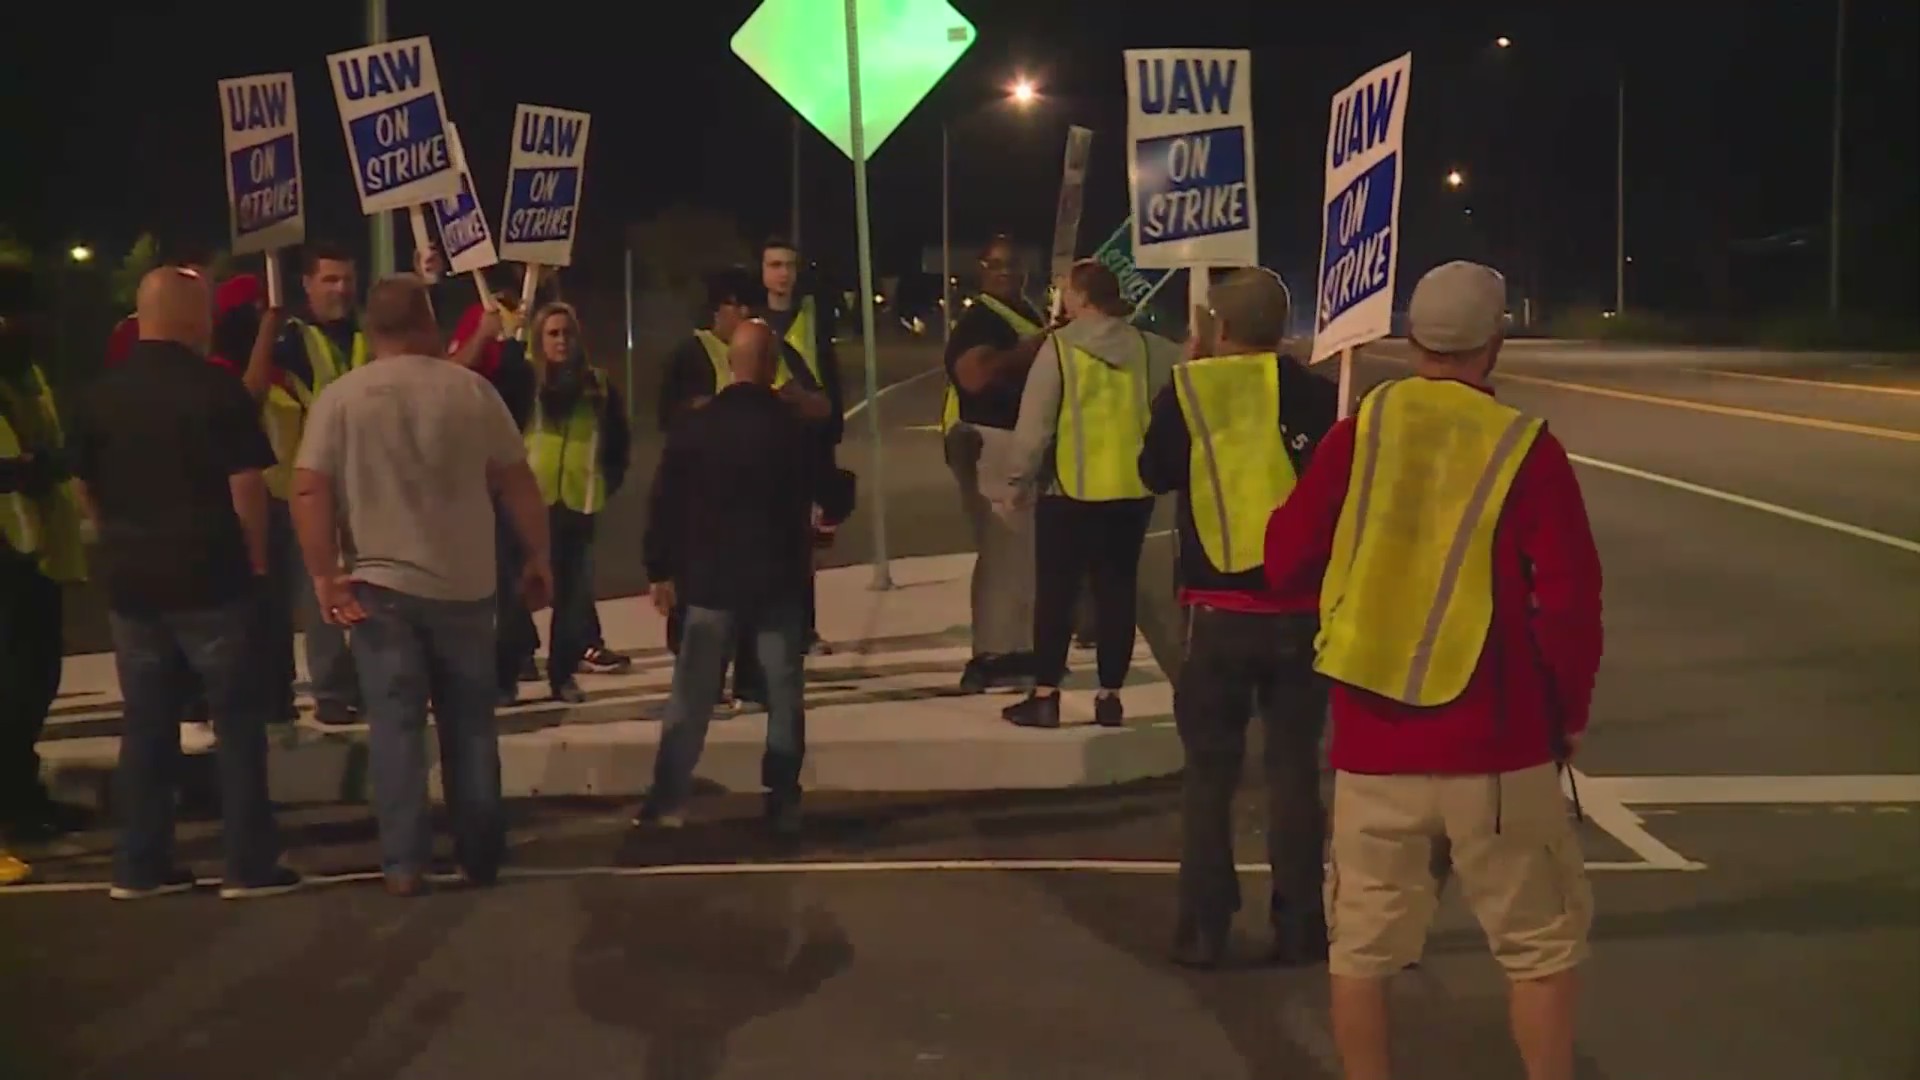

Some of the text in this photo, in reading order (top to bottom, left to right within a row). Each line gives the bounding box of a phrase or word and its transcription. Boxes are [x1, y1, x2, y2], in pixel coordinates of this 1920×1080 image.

[337, 45, 421, 100] UAW
[1137, 59, 1237, 115] UAW
[227, 81, 287, 132] UAW
[375, 105, 409, 148] ON
[1331, 69, 1403, 170] UAW
[520, 112, 582, 158] UAW
[1167, 136, 1211, 183] ON
[250, 147, 276, 184] ON
[365, 134, 447, 190] STRIKE
[529, 171, 560, 202] ON
[237, 177, 298, 230] STRIKE
[508, 205, 574, 242] STRIKE
[1143, 181, 1247, 239] STRIKE
[1338, 175, 1370, 247] ON
[1320, 225, 1391, 326] STRIKE
